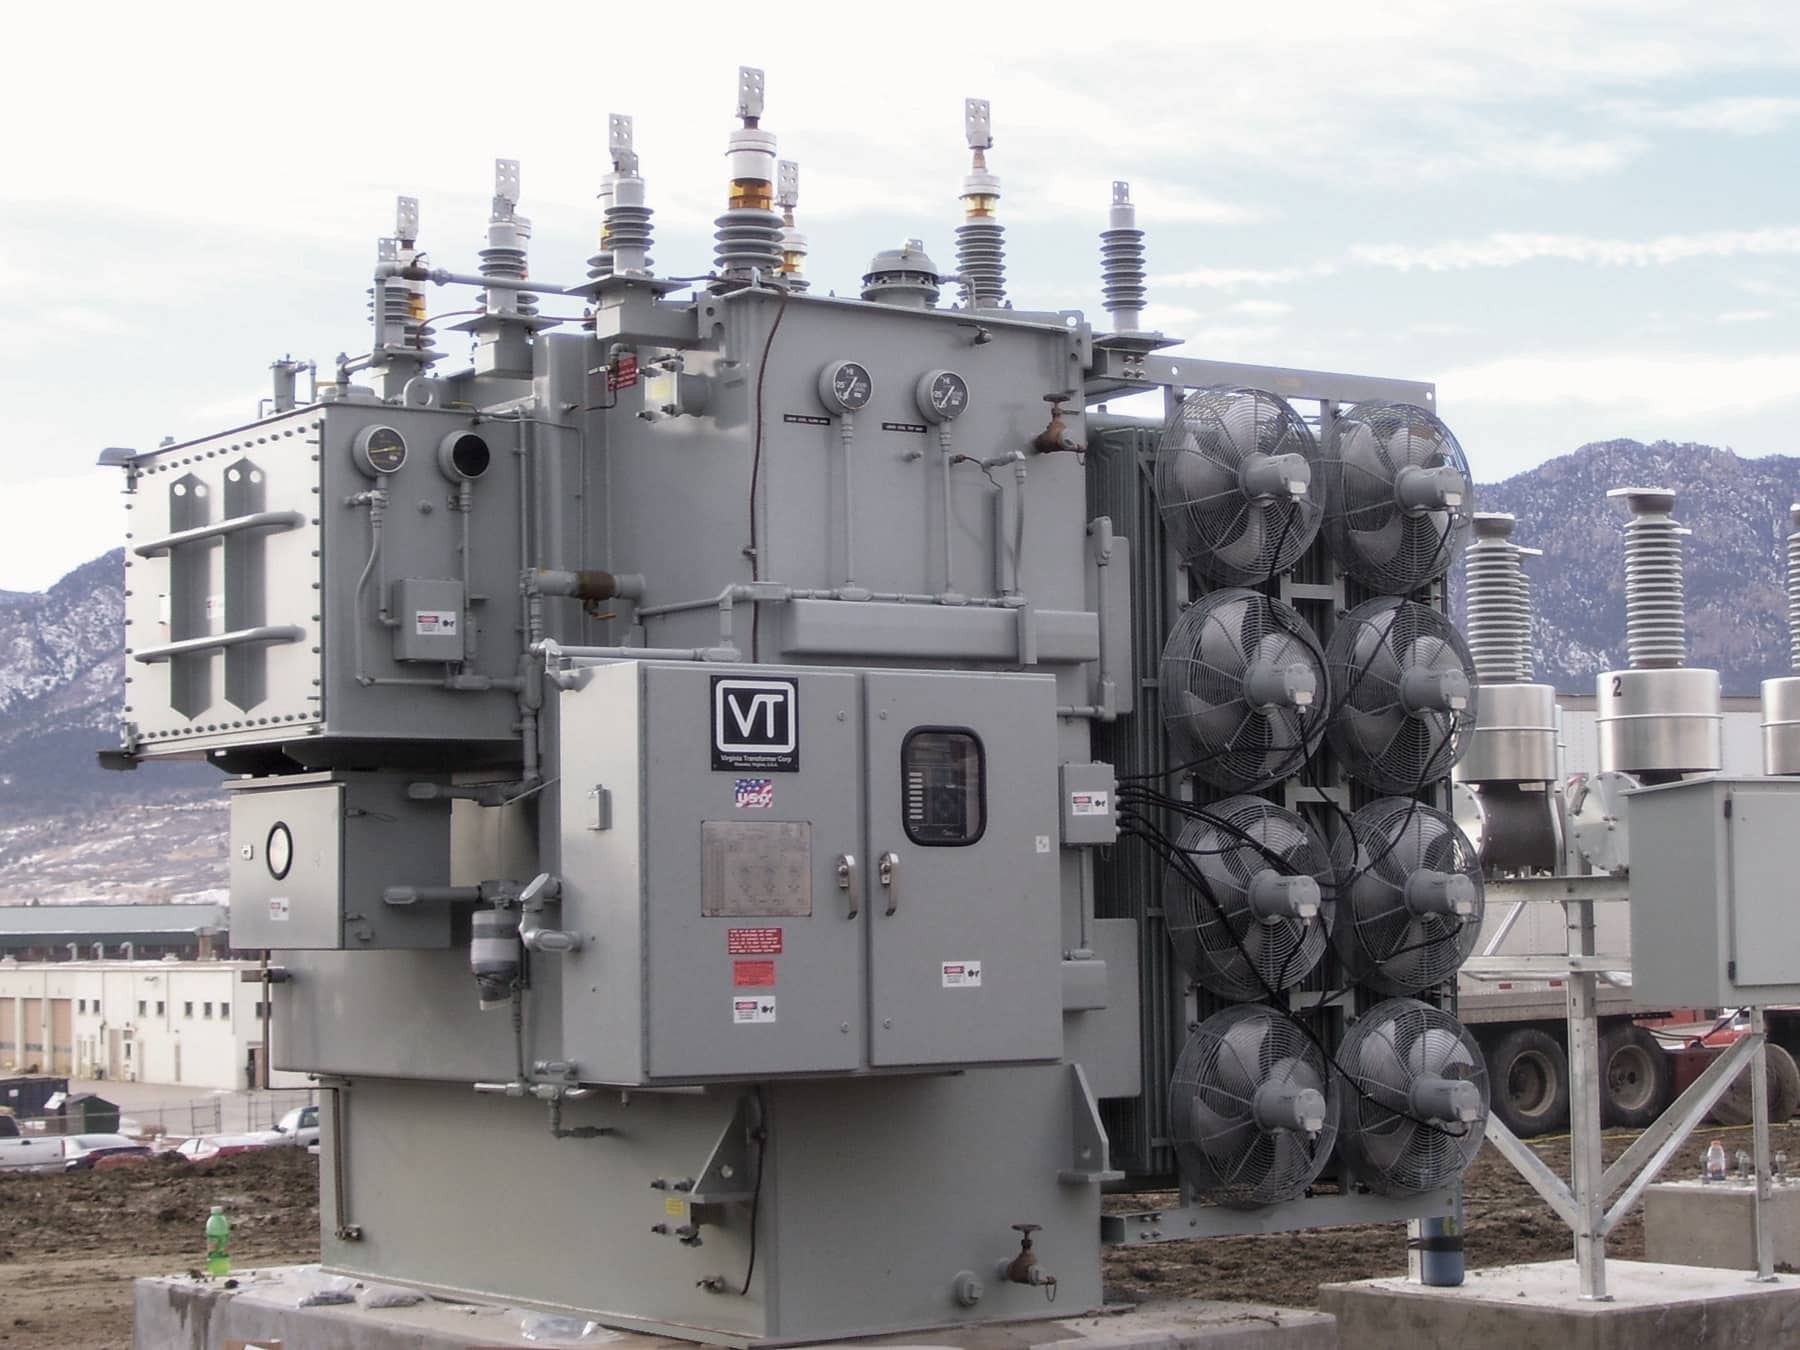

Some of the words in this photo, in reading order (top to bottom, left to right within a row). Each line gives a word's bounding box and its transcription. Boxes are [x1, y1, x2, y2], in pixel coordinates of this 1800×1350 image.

[1612, 676, 1622, 697] 2
[728, 694, 784, 738] VT
[738, 792, 769, 803] USA
